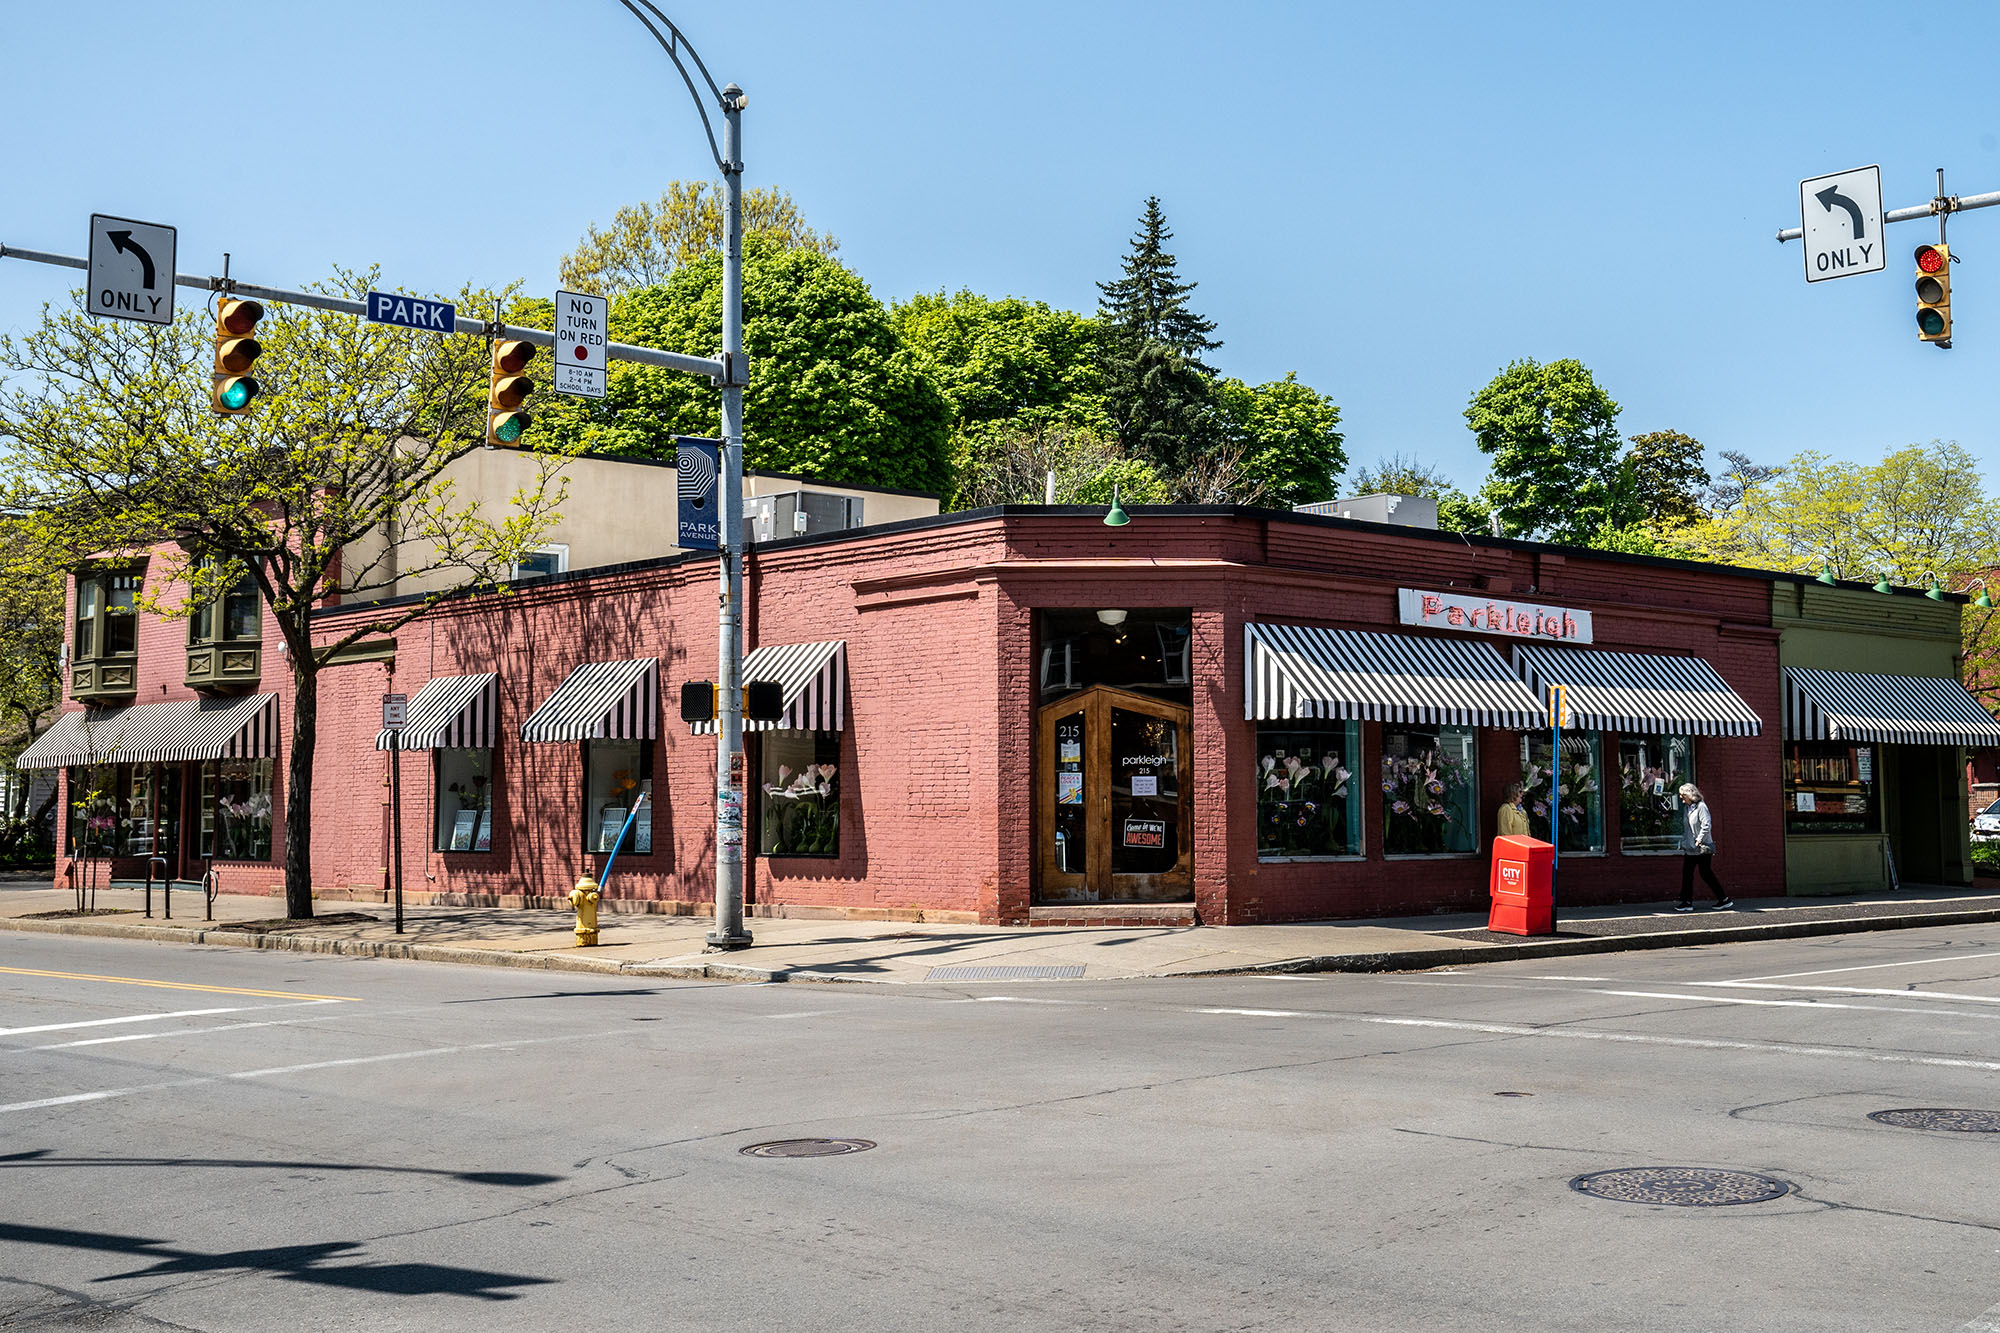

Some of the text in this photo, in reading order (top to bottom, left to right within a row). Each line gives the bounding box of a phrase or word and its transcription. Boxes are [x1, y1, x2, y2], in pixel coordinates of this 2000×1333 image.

[1817, 243, 1873, 271] ONLY
[101, 289, 162, 314] ONLY
[571, 299, 593, 314] NO
[378, 296, 444, 328] PARK
[567, 315, 597, 330] TURN
[560, 329, 603, 346] ON RED
[568, 369, 583, 377] 8-10
[560, 382, 602, 394] SCHOOL DAYS
[680, 522, 717, 533] PARK
[680, 531, 717, 540] AVENUE
[1422, 595, 1578, 638] Parkleigh
[1059, 725, 1080, 737] 215
[1122, 754, 1167, 766] parkleigh
[1126, 832, 1162, 846] AWESOME
[1502, 867, 1521, 878] CITY
